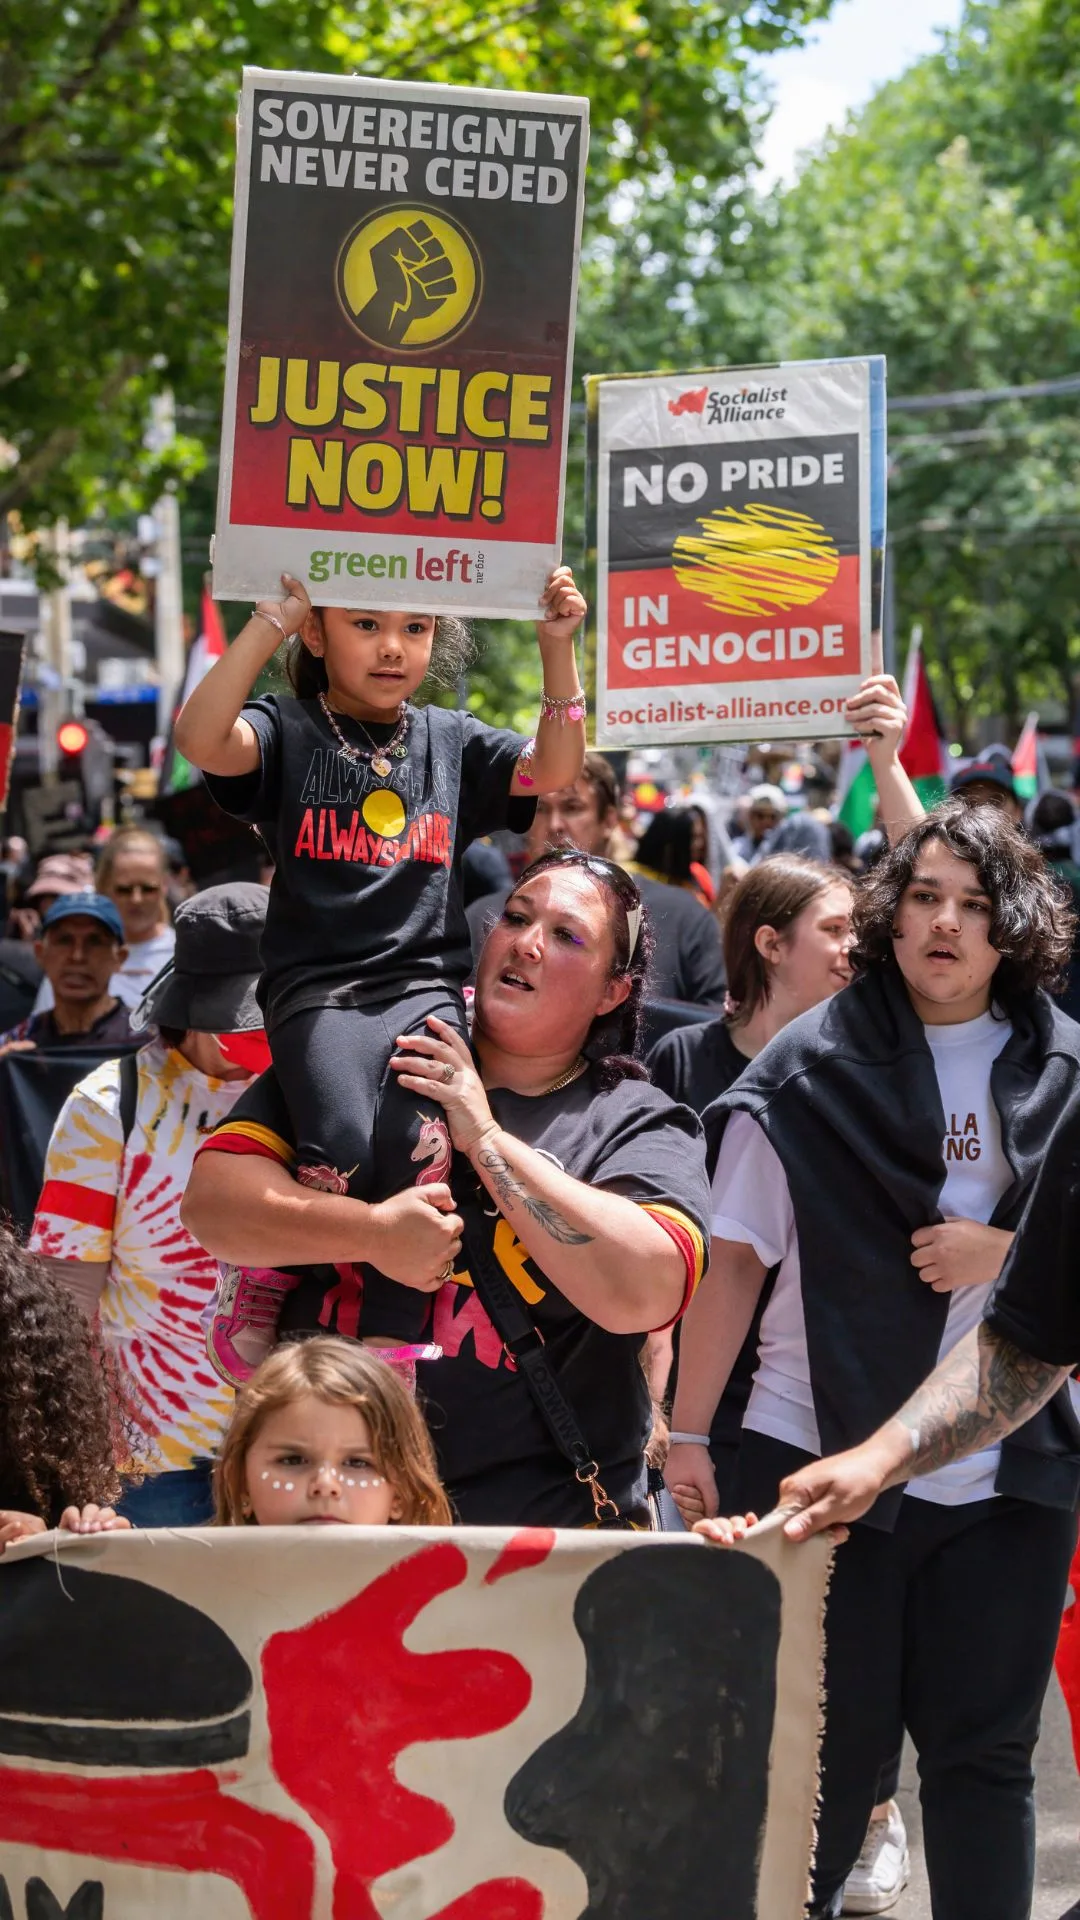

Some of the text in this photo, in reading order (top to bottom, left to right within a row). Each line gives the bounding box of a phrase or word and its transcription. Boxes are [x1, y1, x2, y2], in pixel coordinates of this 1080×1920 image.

[258, 98, 576, 160] SOVEREIGNTY
[260, 144, 568, 205] NEVER CEDED
[250, 356, 552, 441] JUSTICE
[707, 387, 788, 409] Socialist
[707, 405, 785, 425] Alliance
[287, 438, 505, 518] NOW!
[623, 453, 845, 508] NO PRIDE
[308, 550, 407, 583] green
[416, 547, 473, 584] left
[624, 594, 669, 628] IN
[622, 624, 845, 671] GENOCIDE
[606, 697, 848, 726] socialist-alliance.or
[294, 808, 395, 868] ALWAYS
